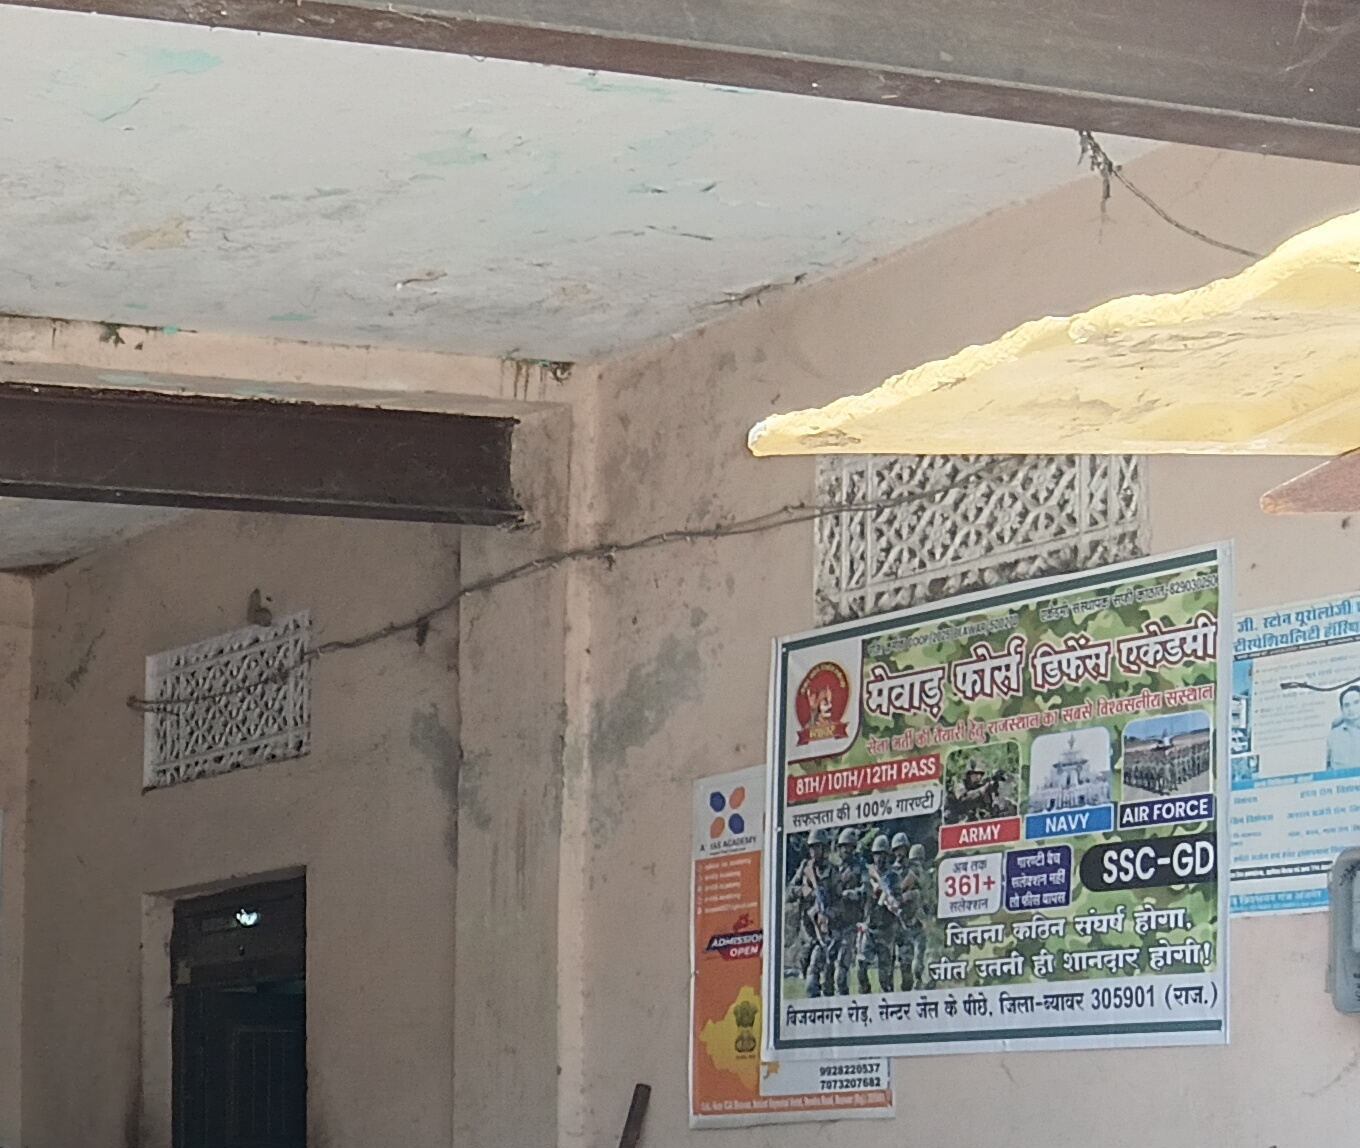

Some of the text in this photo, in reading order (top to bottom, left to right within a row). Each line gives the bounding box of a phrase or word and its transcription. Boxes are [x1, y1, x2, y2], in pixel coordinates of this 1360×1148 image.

[1263, 611, 1292, 630] स्टोन
[1295, 598, 1354, 628] यूरोलोजी
[867, 612, 1217, 720] मेवाड़ फोर्स डिफेंस एकेडमी
[916, 727, 931, 746] की
[934, 723, 966, 744] तैयारी
[968, 719, 985, 743] हेतु
[988, 712, 1041, 735] राजस्थान
[1042, 710, 1059, 725] का
[1062, 699, 1093, 722] सबसे
[1096, 689, 1161, 717] विश्वसनीय
[795, 757, 937, 796] 8TH/10TH/12TH PASS
[792, 789, 935, 828] सफलता की 100% गारण्टी
[958, 798, 1209, 844] ARMY NAVY AIR FORCE
[710, 834, 758, 852] IAS ACADEMY
[953, 859, 987, 874] अब तक
[1011, 867, 1066, 889] सलेक्शन नहीं
[1101, 840, 1214, 885] SSC-GD
[944, 873, 996, 898] 361+
[1009, 891, 1020, 909] तो
[1042, 890, 1067, 905] वापस
[949, 897, 989, 913] सलेक्शन
[945, 901, 1193, 948] जितना कठिन संघर्ष होगा,
[729, 944, 760, 958] OPEN
[928, 940, 1211, 983] जीत उतनी ही शानदार होगी!
[786, 1004, 842, 1027] विजयनगर
[878, 996, 912, 1022] सेन्टर
[944, 992, 959, 1018] के
[997, 990, 1085, 1017] जिला-ब्यावर
[1090, 983, 1157, 1012] 305901
[1163, 980, 1220, 1010] (राज.)
[819, 1077, 882, 1091] 7073207682
